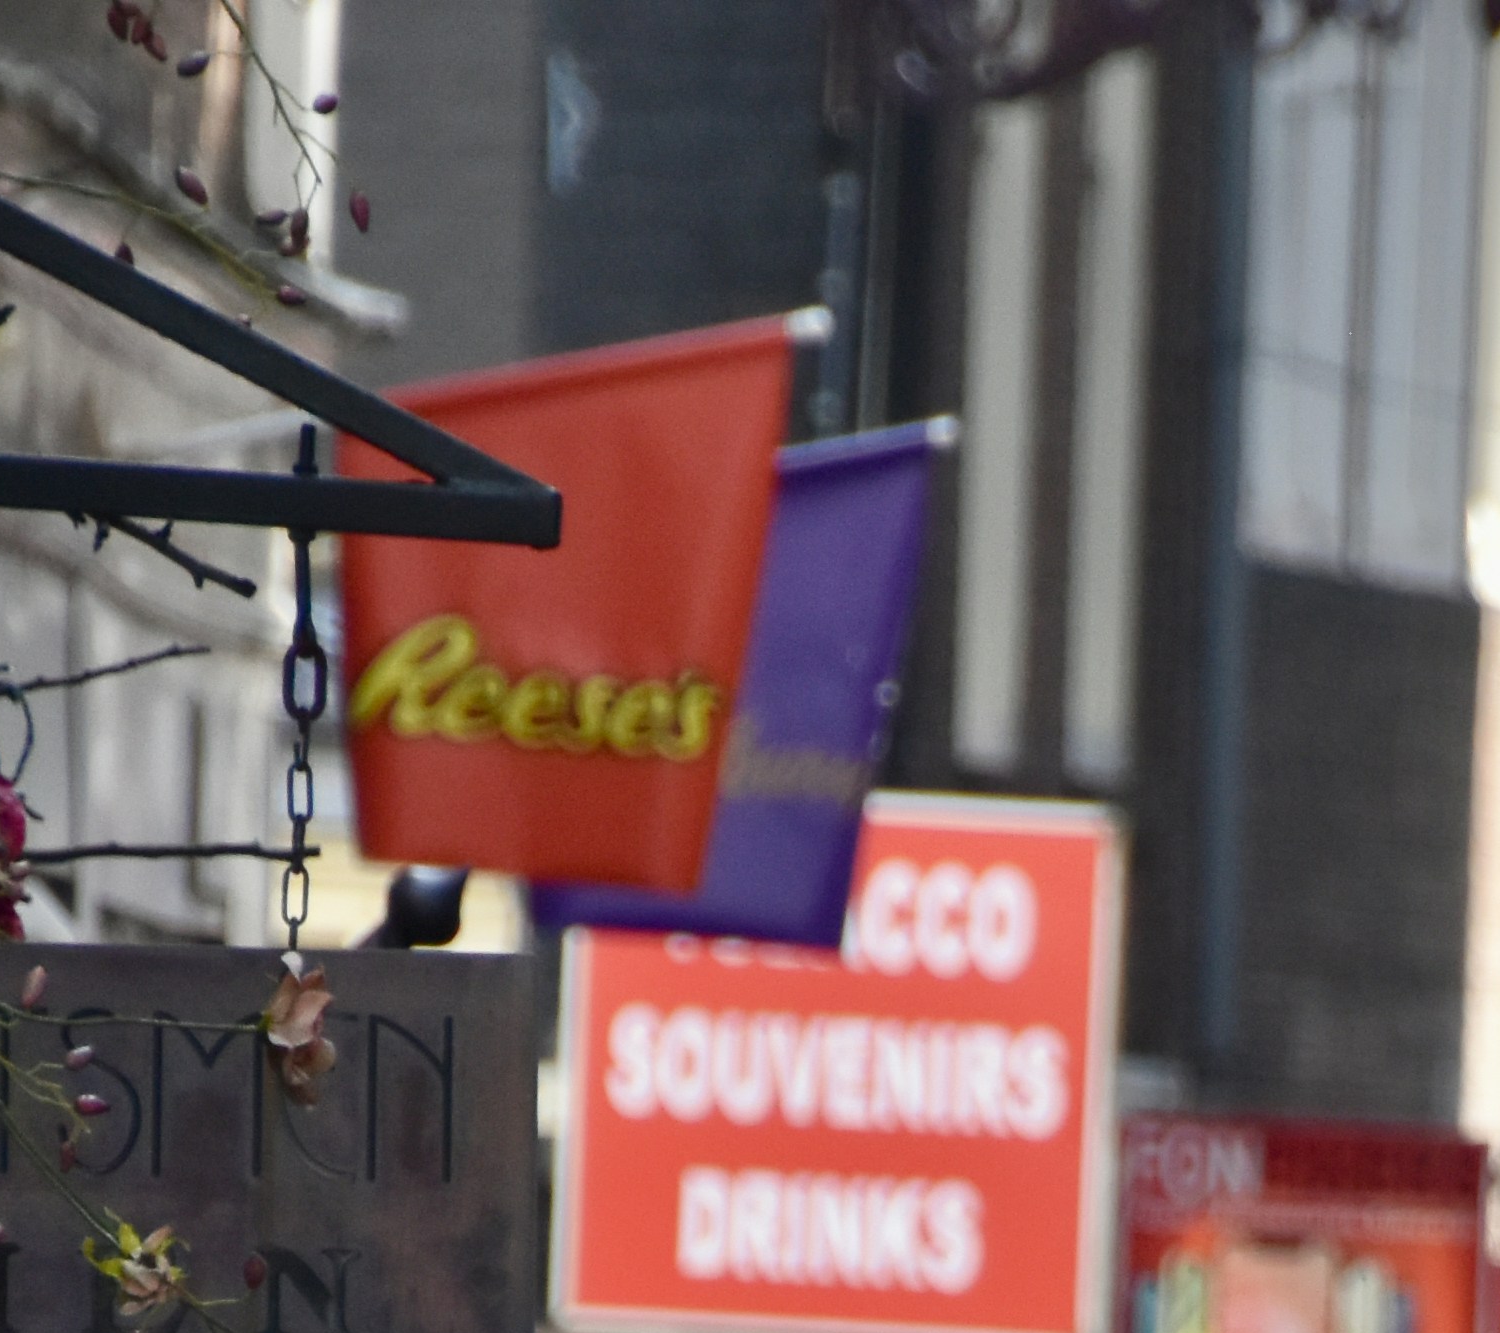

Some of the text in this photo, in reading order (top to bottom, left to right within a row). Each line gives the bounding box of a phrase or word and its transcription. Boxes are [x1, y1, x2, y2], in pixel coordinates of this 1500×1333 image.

[350, 612, 726, 764] Reese's
[604, 1000, 1068, 1140] SOUVENIRS
[677, 1167, 983, 1293] DRINKS
